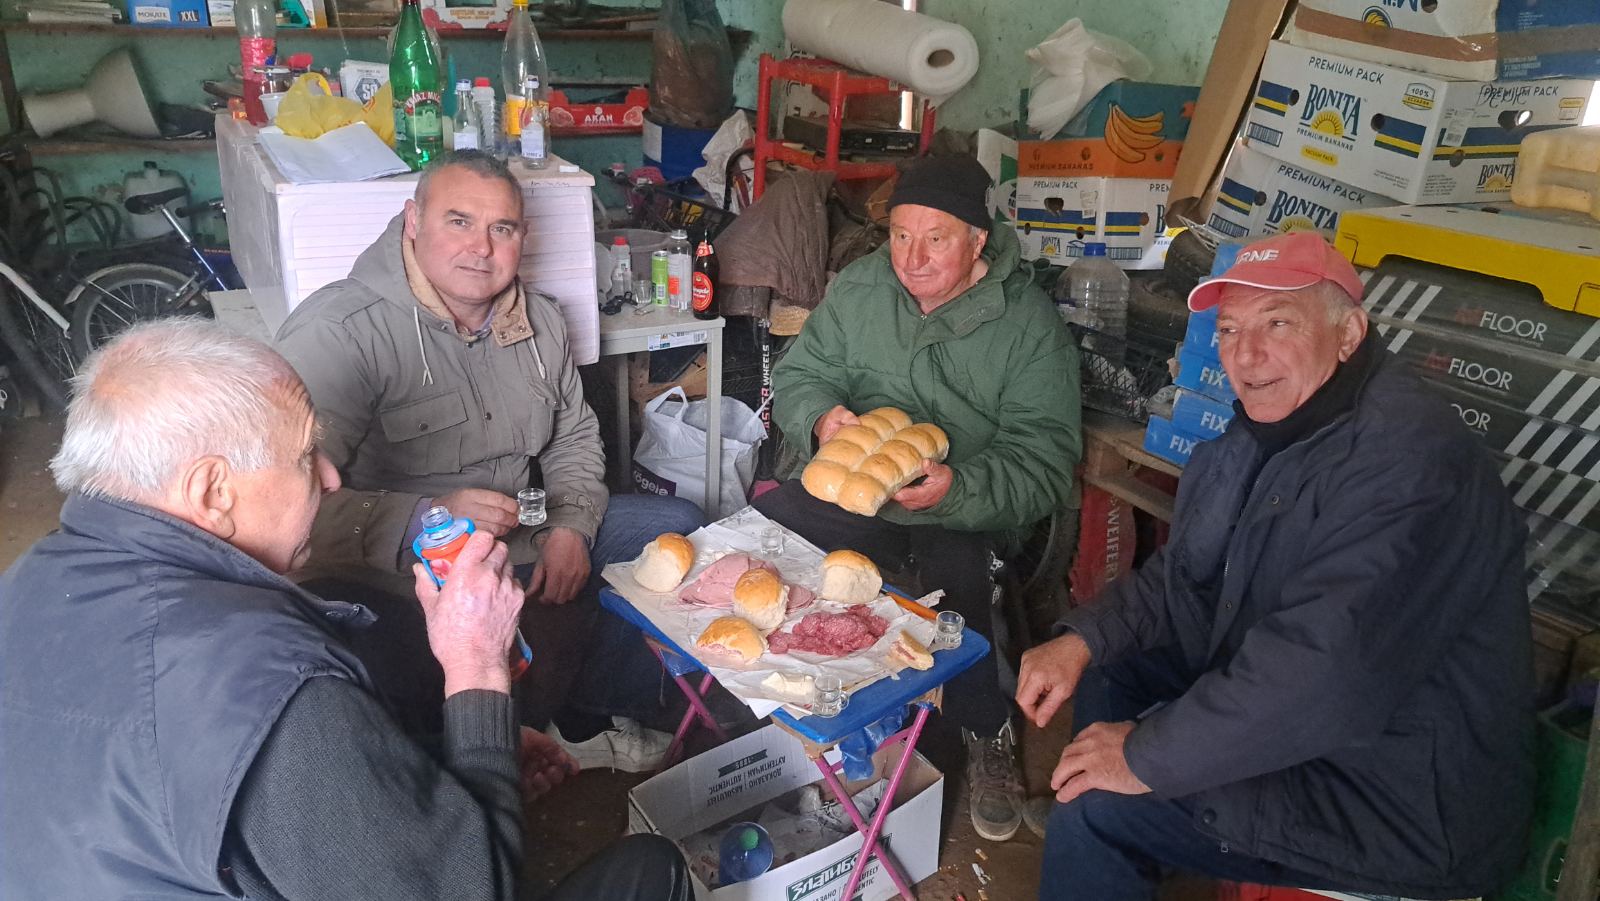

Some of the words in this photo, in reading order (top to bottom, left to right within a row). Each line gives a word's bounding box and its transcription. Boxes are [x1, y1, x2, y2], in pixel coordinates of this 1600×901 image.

[180, 10, 198, 22] XXL
[1308, 56, 1354, 77] PREMIUM
[1354, 67, 1385, 85] PACK
[1411, 87, 1430, 98] 100%
[1533, 85, 1560, 97] PACK
[1300, 83, 1362, 136] BONITA
[1296, 127, 1324, 143] PREMIUM
[1324, 135, 1354, 152] BANANAS
[1033, 180, 1060, 189] PREMIUM
[1061, 180, 1078, 189] PACK
[1277, 164, 1331, 192] PREMIUM
[1332, 184, 1367, 205] PACK
[1265, 189, 1339, 231] BONITA
[1479, 310, 1548, 342] FLOOR
[762, 344, 771, 386] WHEELS
[1447, 357, 1514, 391] FLOOR
[1199, 366, 1227, 389] FIX
[1199, 411, 1230, 434] FIX
[1169, 435, 1197, 456] FIX
[708, 774, 742, 795] AUTHENTIC
